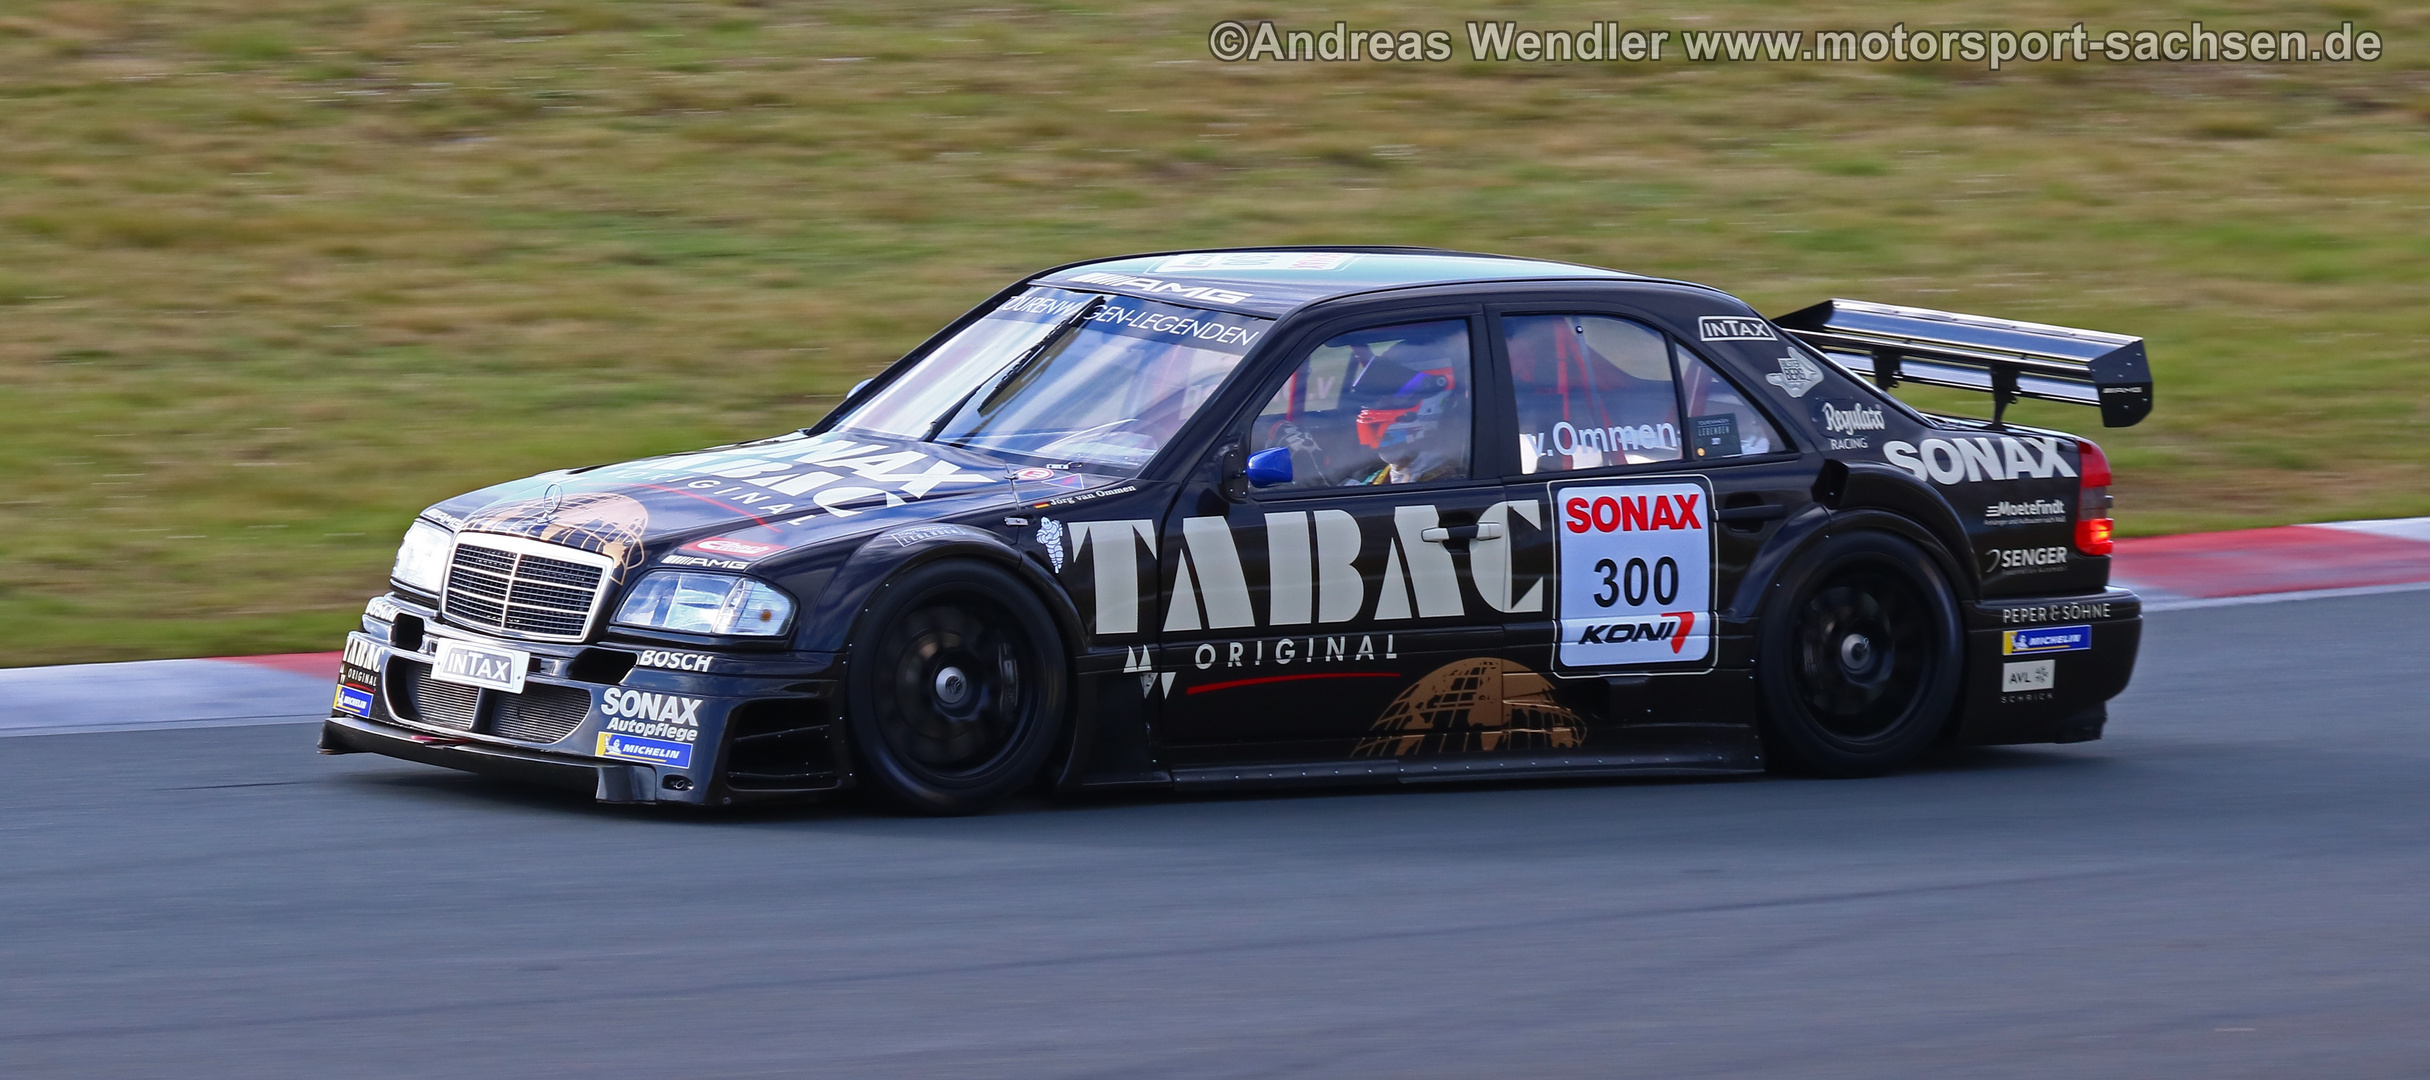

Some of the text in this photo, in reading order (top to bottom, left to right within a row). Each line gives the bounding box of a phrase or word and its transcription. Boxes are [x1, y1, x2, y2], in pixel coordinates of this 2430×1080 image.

[1704, 320, 1769, 337] INTAX
[1830, 438, 1868, 450] RACING
[1883, 437, 2079, 485] SONAX
[1076, 493, 1096, 502] van
[1096, 485, 1137, 498] Ommen
[1566, 494, 1702, 533] SONAX
[687, 558, 751, 569] AMG
[1067, 499, 1544, 635] TABAC
[2001, 547, 2068, 567] SENGER
[1593, 556, 1679, 608] 300
[2003, 607, 2047, 623] PEPER
[2062, 602, 2111, 620] SÖHNE
[1578, 622, 1677, 644] KONI
[2028, 634, 2082, 646] MICHELIN
[639, 650, 714, 673] BOSCH
[1194, 633, 1398, 670] ORIGINAL
[447, 651, 511, 682] INTAX
[347, 668, 377, 687] ORIGINAL
[2009, 671, 2032, 685] AVL
[600, 687, 703, 727] SONAX
[606, 717, 698, 742] Autopflege
[622, 743, 681, 759] MICHELIN
